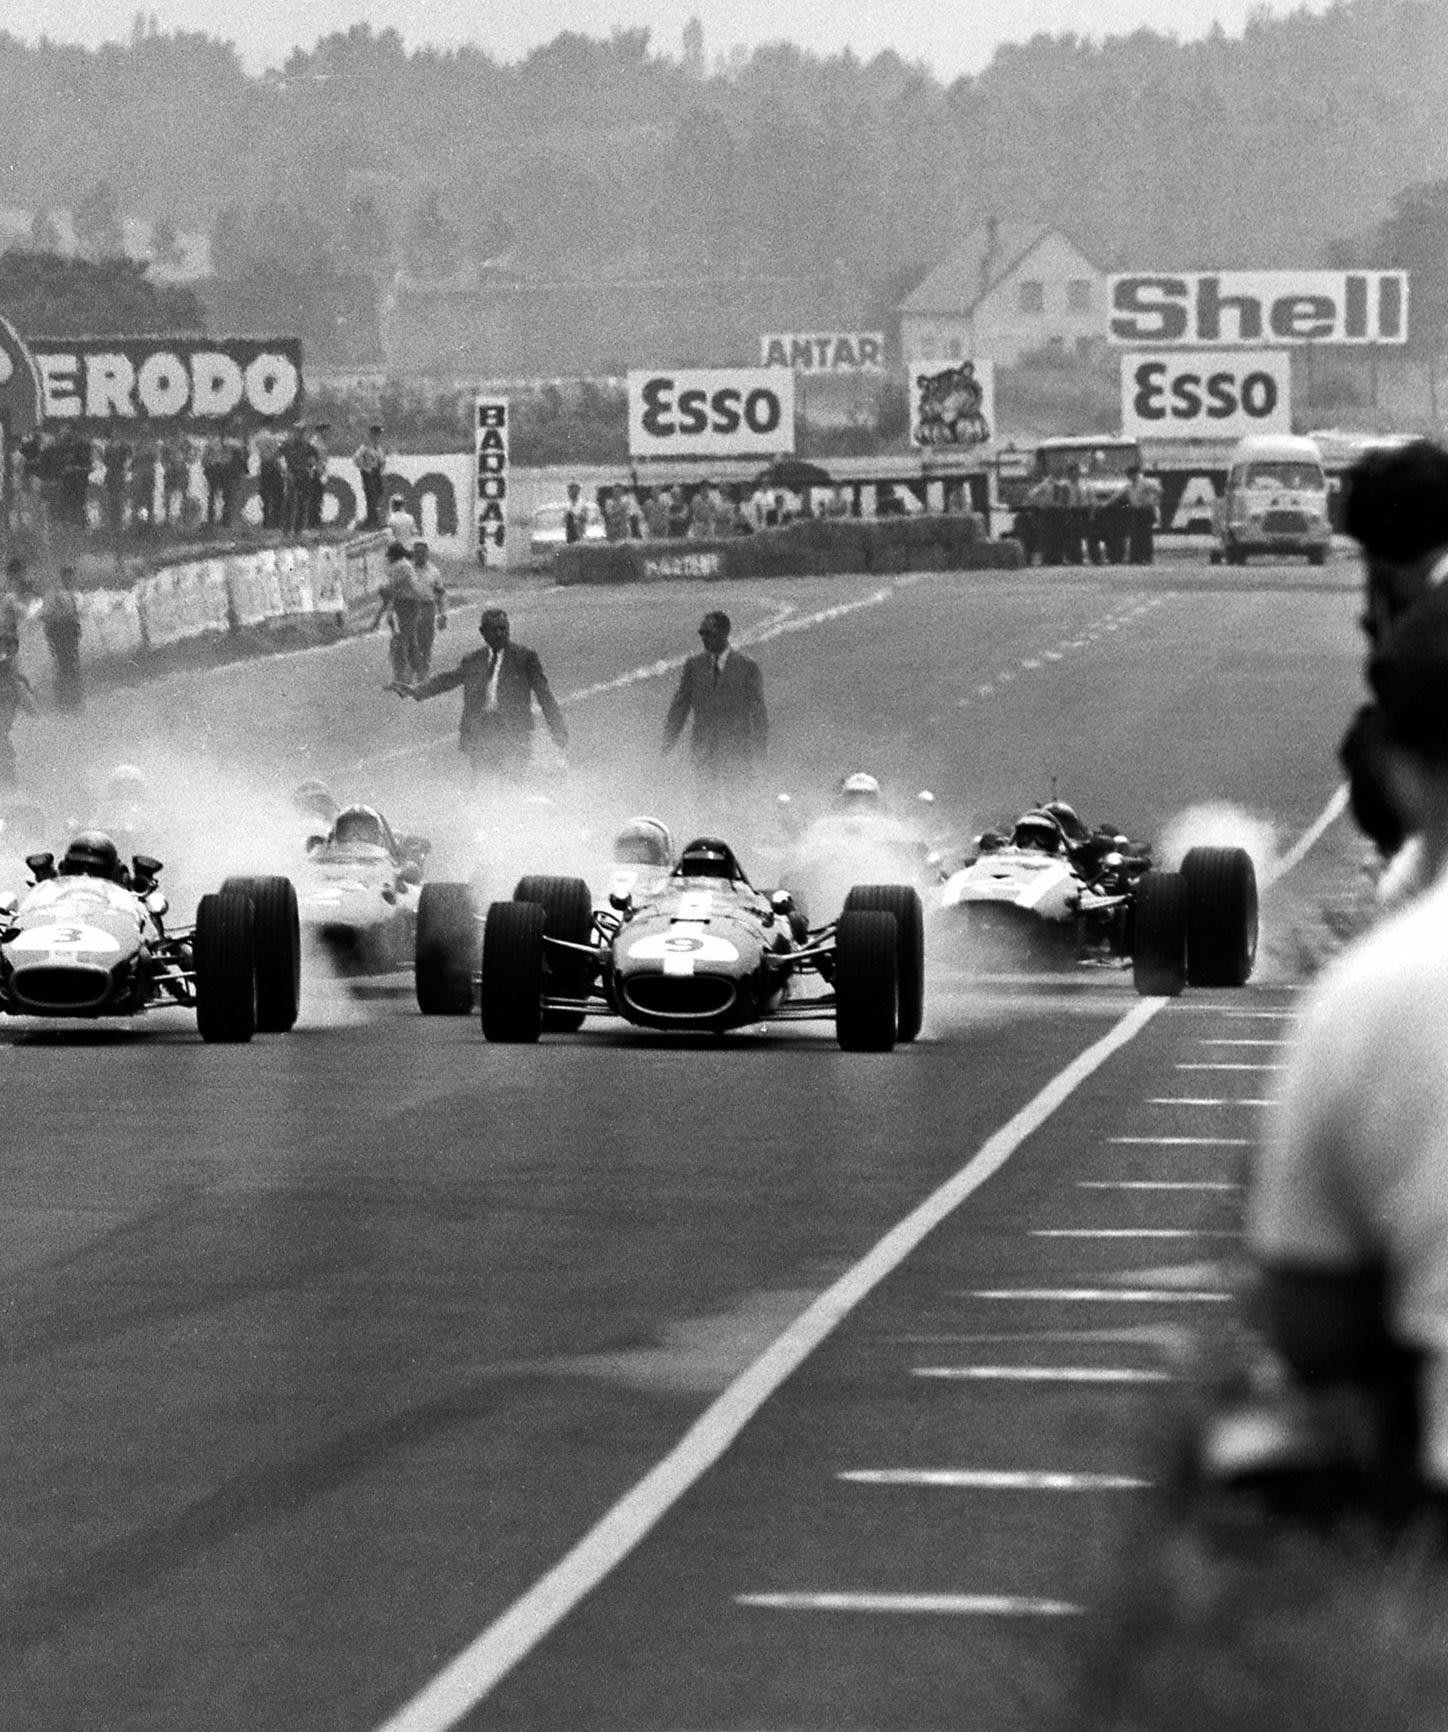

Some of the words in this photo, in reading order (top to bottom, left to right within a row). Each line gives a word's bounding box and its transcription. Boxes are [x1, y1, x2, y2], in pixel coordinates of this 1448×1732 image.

[1110, 276, 1401, 340] Shell
[766, 338, 880, 368] ANTAR
[36, 352, 298, 417] ERODO
[53, 927, 83, 943] 3
[665, 937, 705, 953] 9
